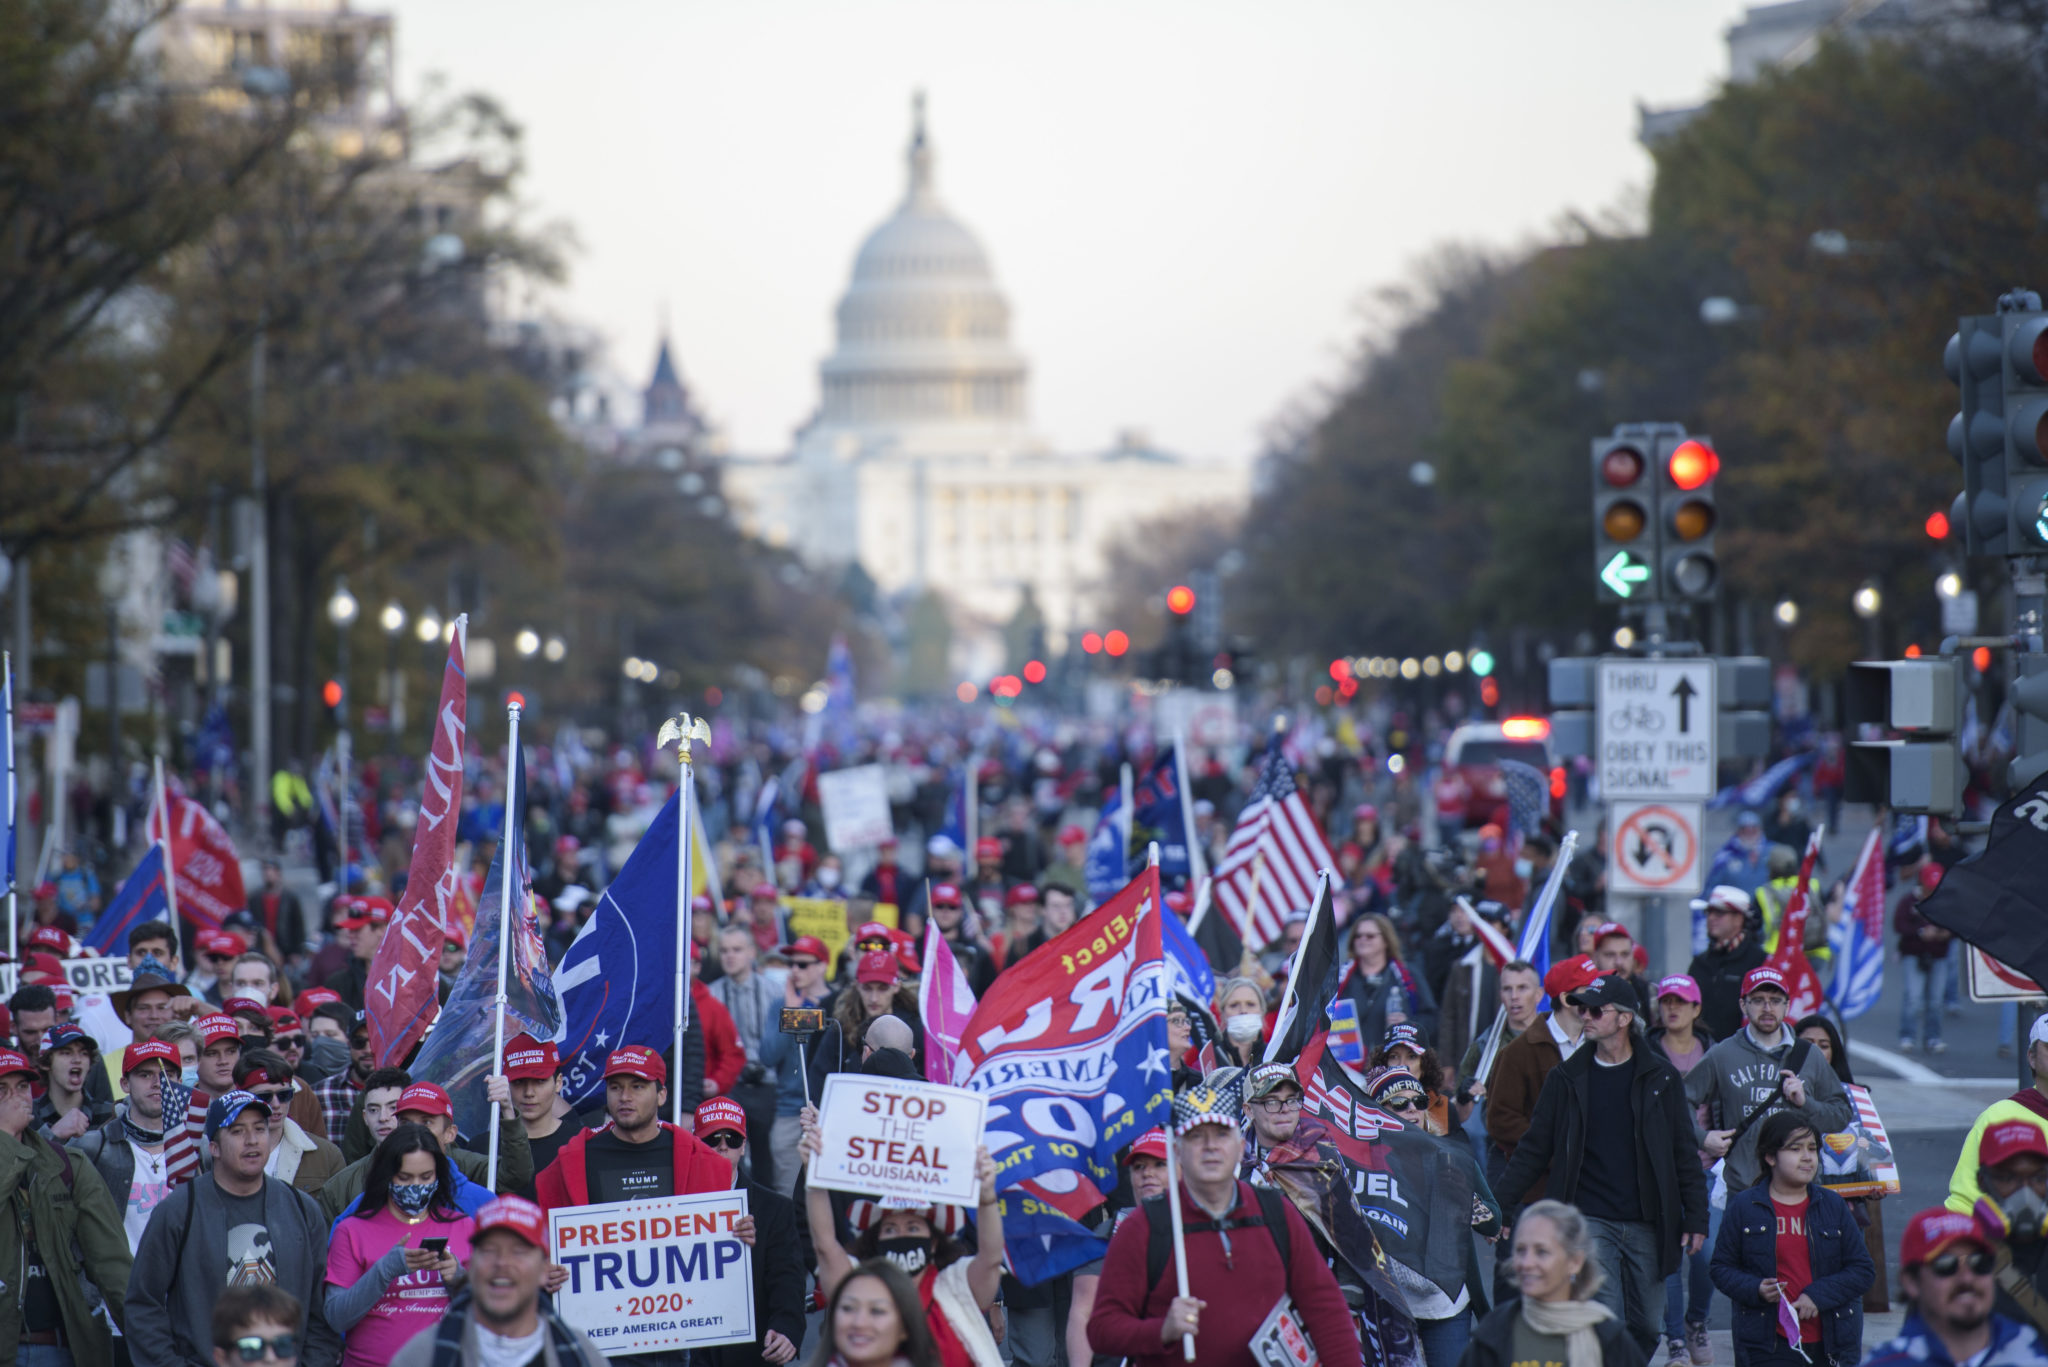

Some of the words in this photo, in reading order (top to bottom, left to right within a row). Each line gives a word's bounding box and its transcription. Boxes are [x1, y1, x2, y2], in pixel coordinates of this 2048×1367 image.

[1608, 670, 1657, 690] THRU
[1607, 742, 1654, 761] OBEY
[1667, 742, 1707, 761] THIS
[1608, 769, 1673, 788] SIGNAL
[64, 963, 131, 987] ORE
[1662, 977, 1691, 987] TRUMP
[1750, 971, 1783, 982] TRUMP
[560, 1051, 598, 1098] RST
[1253, 1064, 1290, 1080] TRUMP
[699, 1102, 717, 1115] MAKE
[717, 1102, 744, 1116] AMERICA
[862, 1091, 946, 1121] STOP
[702, 1112, 723, 1124] GREAT
[724, 1112, 742, 1125] AGAIN
[878, 1116, 926, 1143] THE
[847, 1136, 948, 1170] STEAL
[622, 1175, 658, 1184] TRUMP
[848, 1162, 941, 1185] LOUISIANA
[559, 1209, 740, 1249] PRESIDENT
[560, 1239, 742, 1294] TRUMP
[627, 1293, 683, 1317] 2020
[587, 1325, 619, 1338] KEEP
[622, 1320, 677, 1335] AMERICA
[681, 1316, 723, 1329] GREAT!
